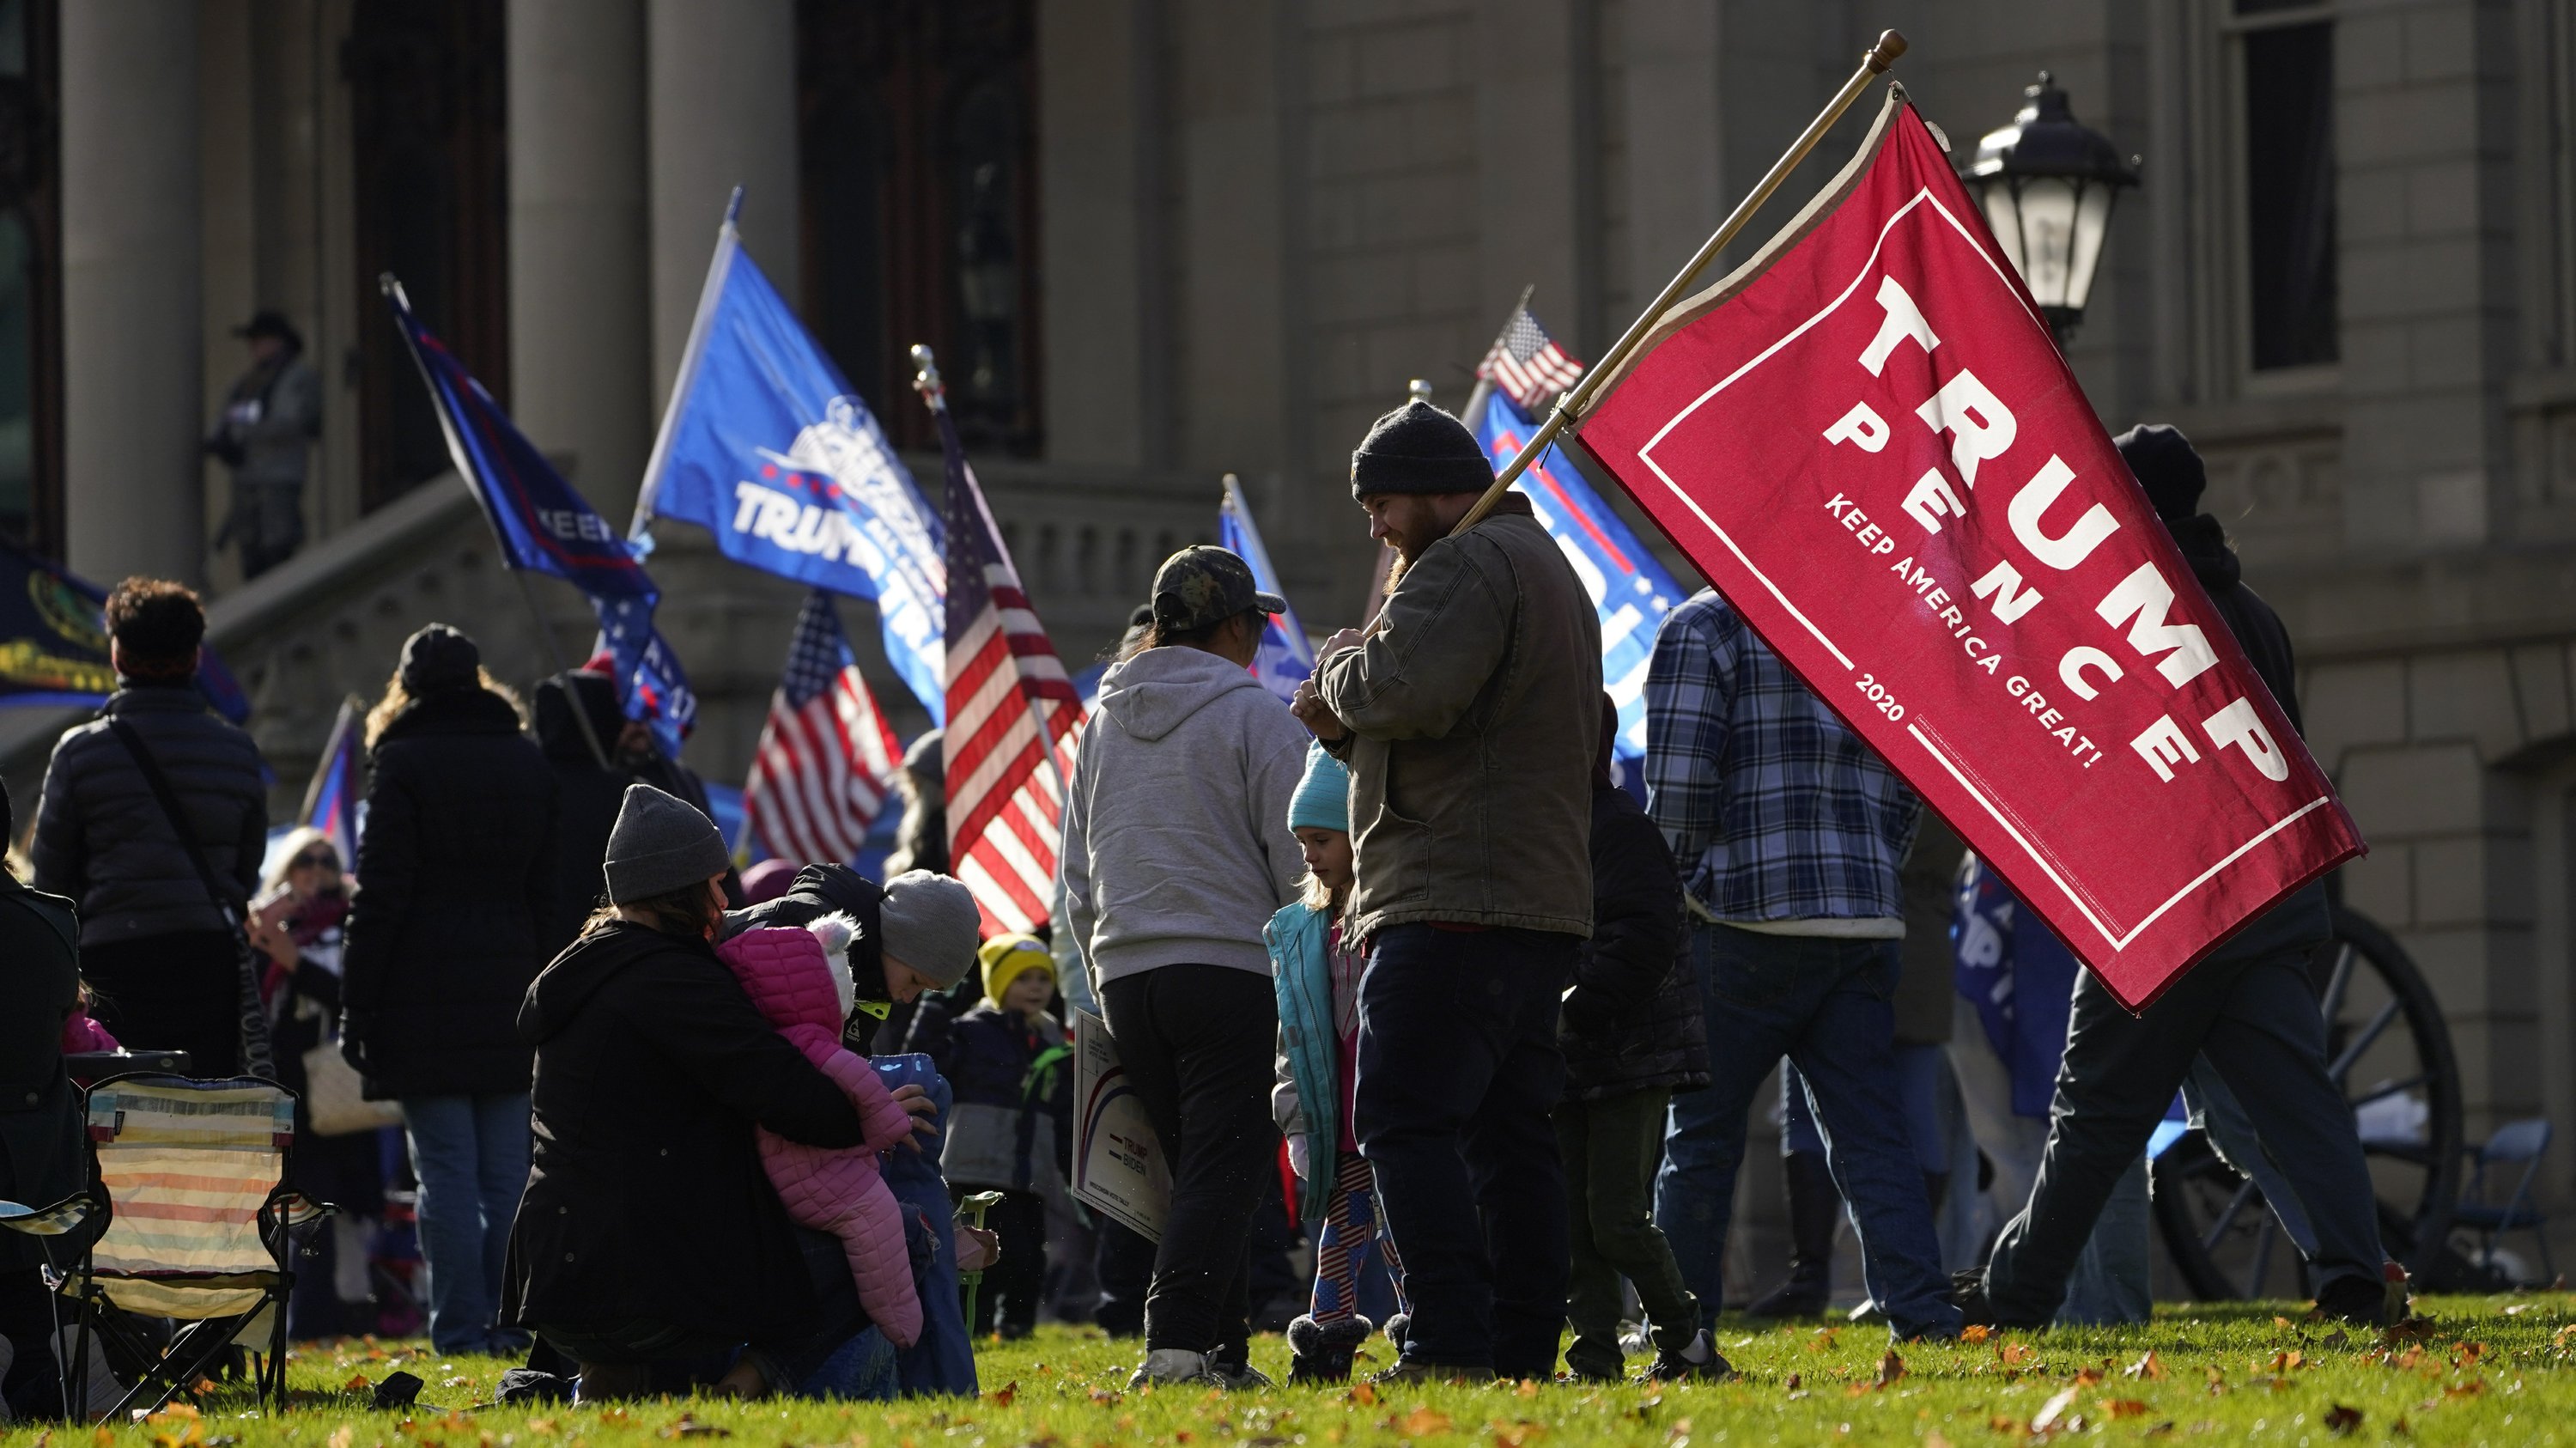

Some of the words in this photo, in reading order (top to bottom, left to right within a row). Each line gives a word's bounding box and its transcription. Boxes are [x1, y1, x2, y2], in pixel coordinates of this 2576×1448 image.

[1822, 400, 2202, 783] PENCE
[1857, 274, 2289, 782] TRUMP
[1824, 492, 1895, 555] KEEP
[1890, 556, 2002, 675] AMERICA
[2006, 675, 2103, 769] GREAT!
[1855, 672, 1905, 721] 2020
[1123, 1136, 1147, 1159] TRUMP
[1123, 1153, 1146, 1176] BIDEN
